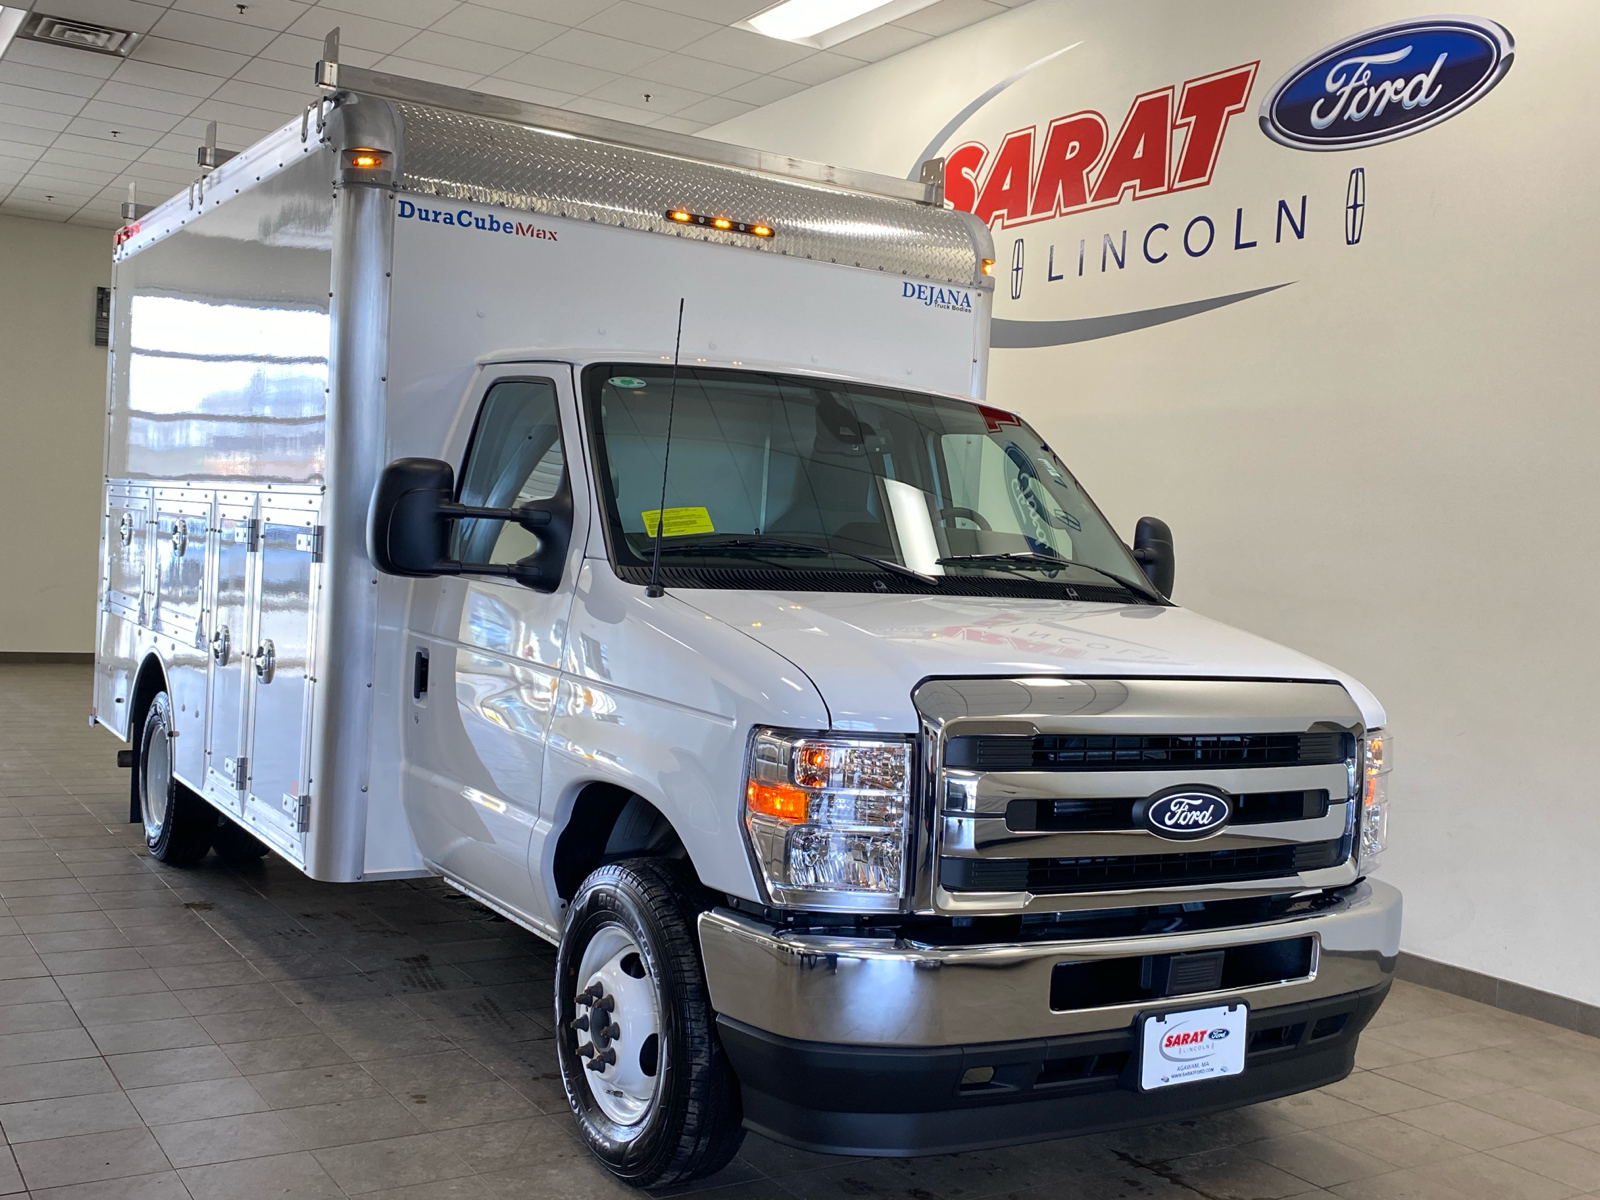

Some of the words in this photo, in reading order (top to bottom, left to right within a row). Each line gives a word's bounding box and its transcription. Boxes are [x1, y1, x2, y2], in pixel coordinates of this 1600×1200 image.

[944, 60, 1261, 231] SARAT
[1310, 45, 1448, 129] Ford
[1048, 195, 1307, 282] LINCOLN
[902, 281, 972, 307] DEJANA
[934, 302, 950, 310] Truck
[951, 305, 972, 313] Bodies
[1164, 798, 1215, 825] Ford
[1164, 1029, 1208, 1048] SARAT
[1211, 1030, 1227, 1039] Ford
[1183, 1044, 1210, 1053] LINCOLN
